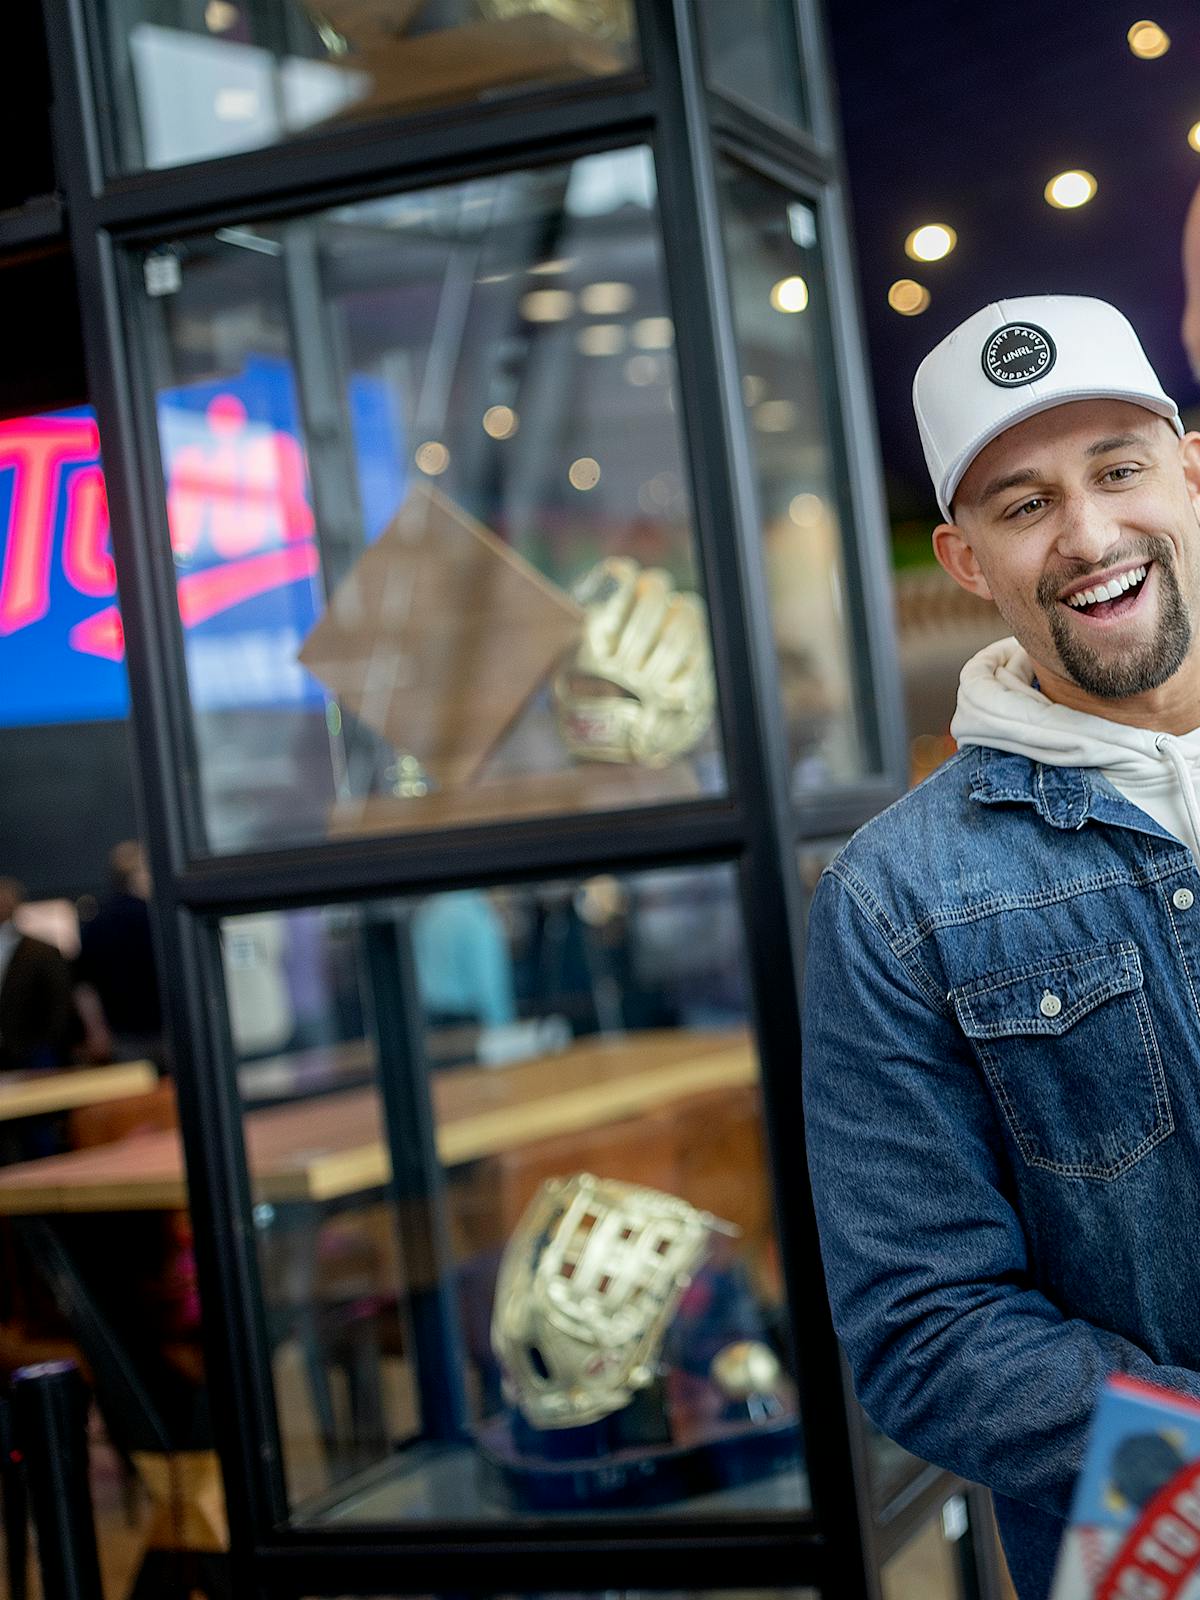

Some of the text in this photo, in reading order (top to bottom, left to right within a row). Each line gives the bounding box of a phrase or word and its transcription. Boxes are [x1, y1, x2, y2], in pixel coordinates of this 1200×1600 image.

[989, 329, 1043, 363] SAINT PAUL
[1002, 345, 1033, 363] UNRL
[995, 352, 1047, 379] SUPPLY CO
